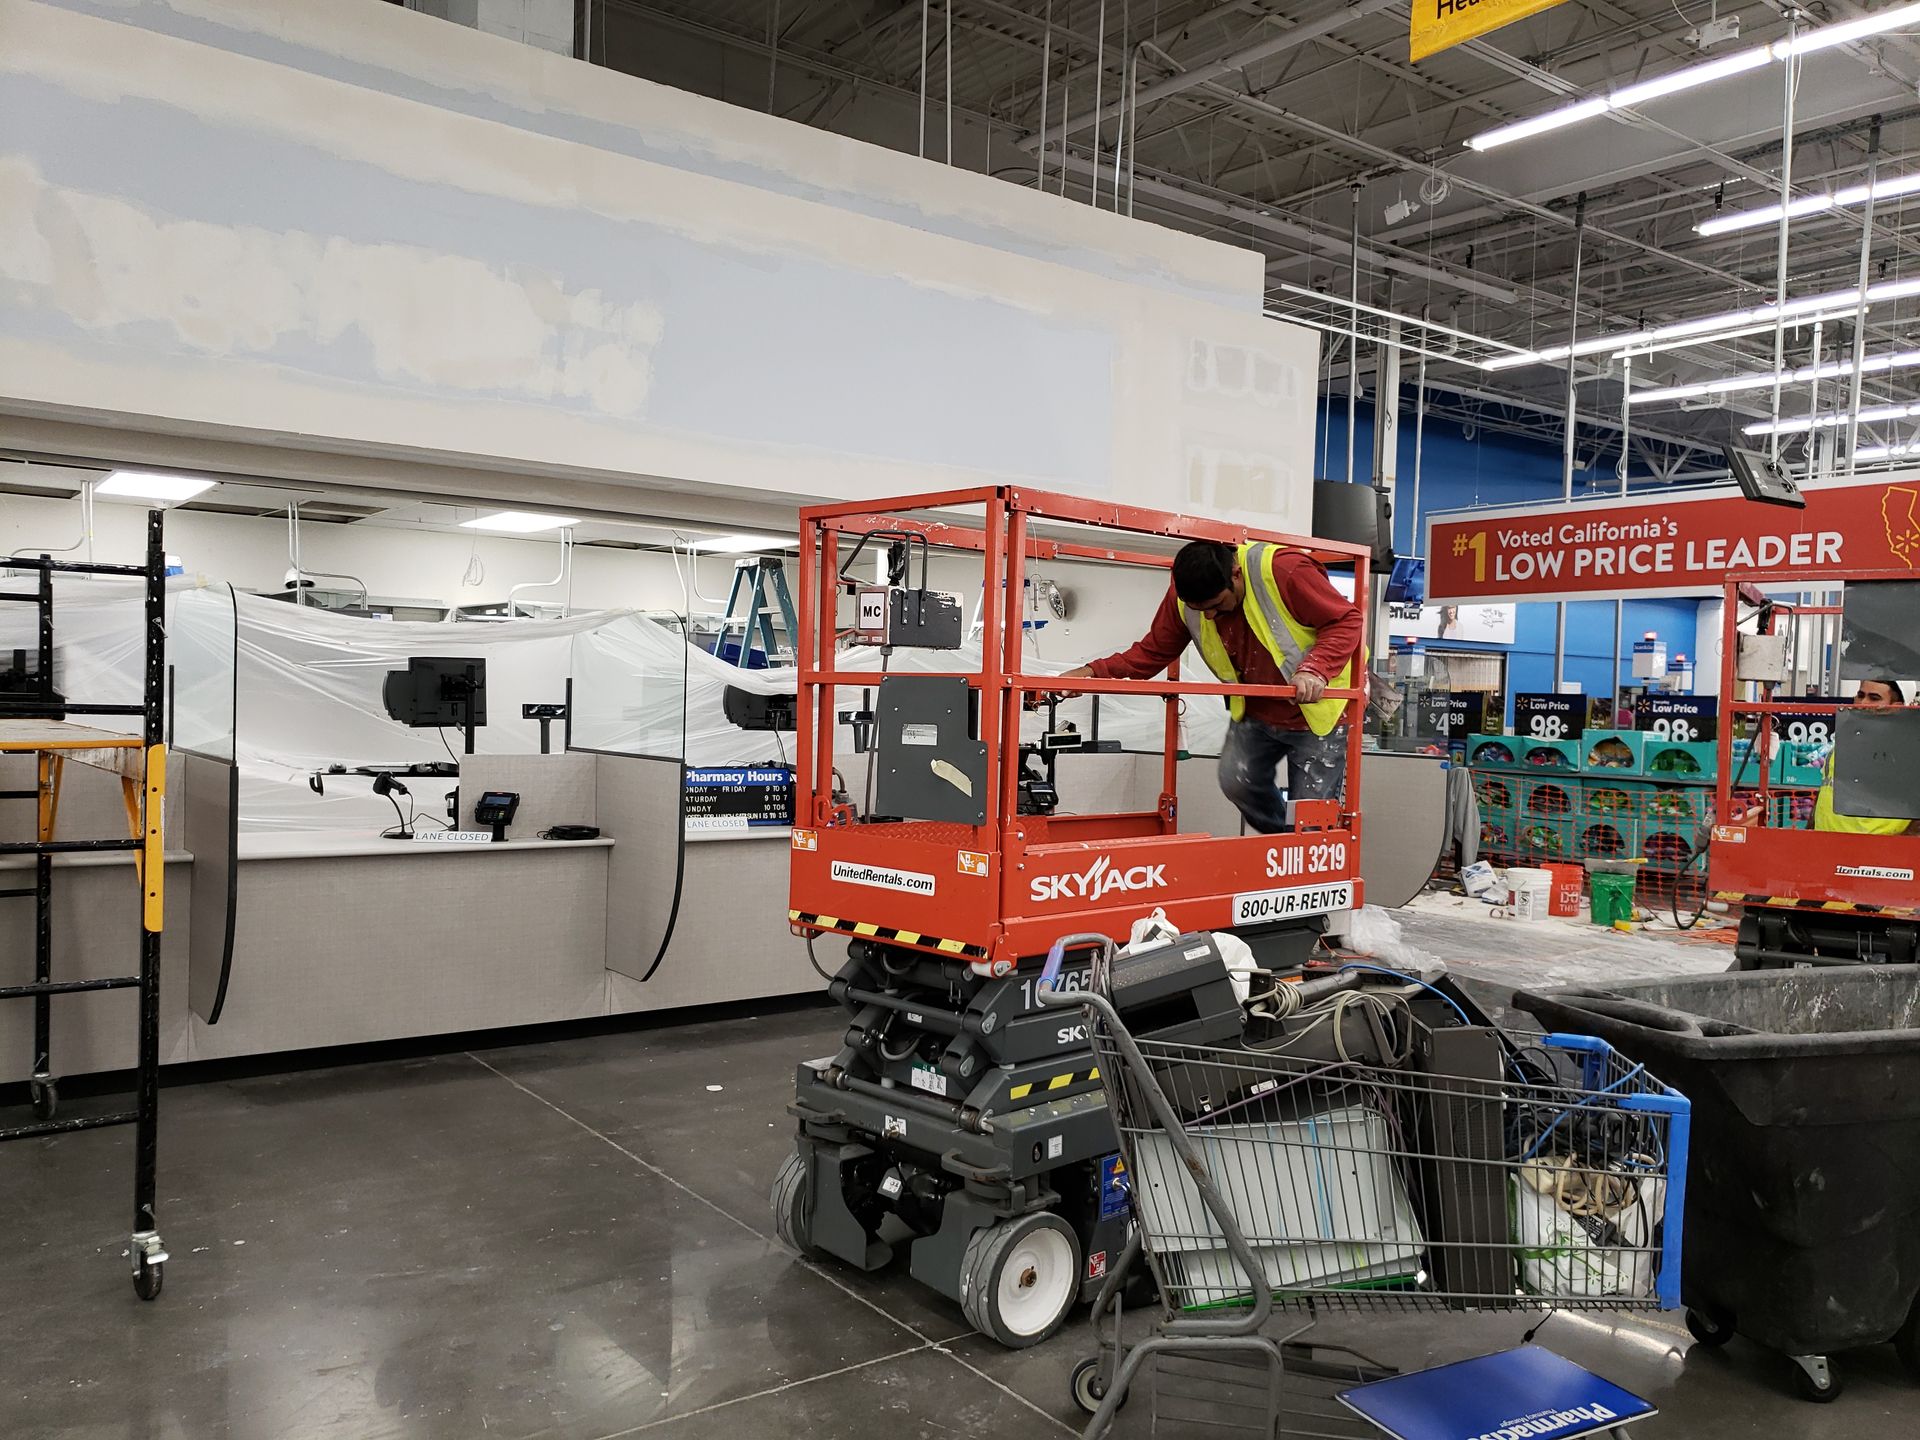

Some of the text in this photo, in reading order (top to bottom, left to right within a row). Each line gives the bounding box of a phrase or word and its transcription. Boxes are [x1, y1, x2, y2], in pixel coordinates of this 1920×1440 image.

[1498, 516, 1678, 548] Voted California's
[1452, 532, 1487, 582] #1
[1495, 531, 1844, 581] LOW PRICE LEADER
[863, 606, 881, 617] MC
[1431, 700, 1467, 708] Low Price
[1530, 702, 1570, 711] Low Price
[1653, 704, 1698, 713] Low Price
[686, 771, 783, 784] Pharmacy Hours
[685, 795, 717, 803] ATURDAY
[687, 820, 745, 829] LANE CLOSED
[415, 832, 489, 841] LANE CLOSED
[1308, 843, 1345, 873] 3219
[833, 865, 933, 891] UnitedRentals.com
[1030, 855, 1168, 901] SKYJACK
[1240, 888, 1347, 918] 800-UR-RENTS
[1560, 904, 1578, 912] THIS
[1466, 1402, 1618, 1440] Pharmacis
